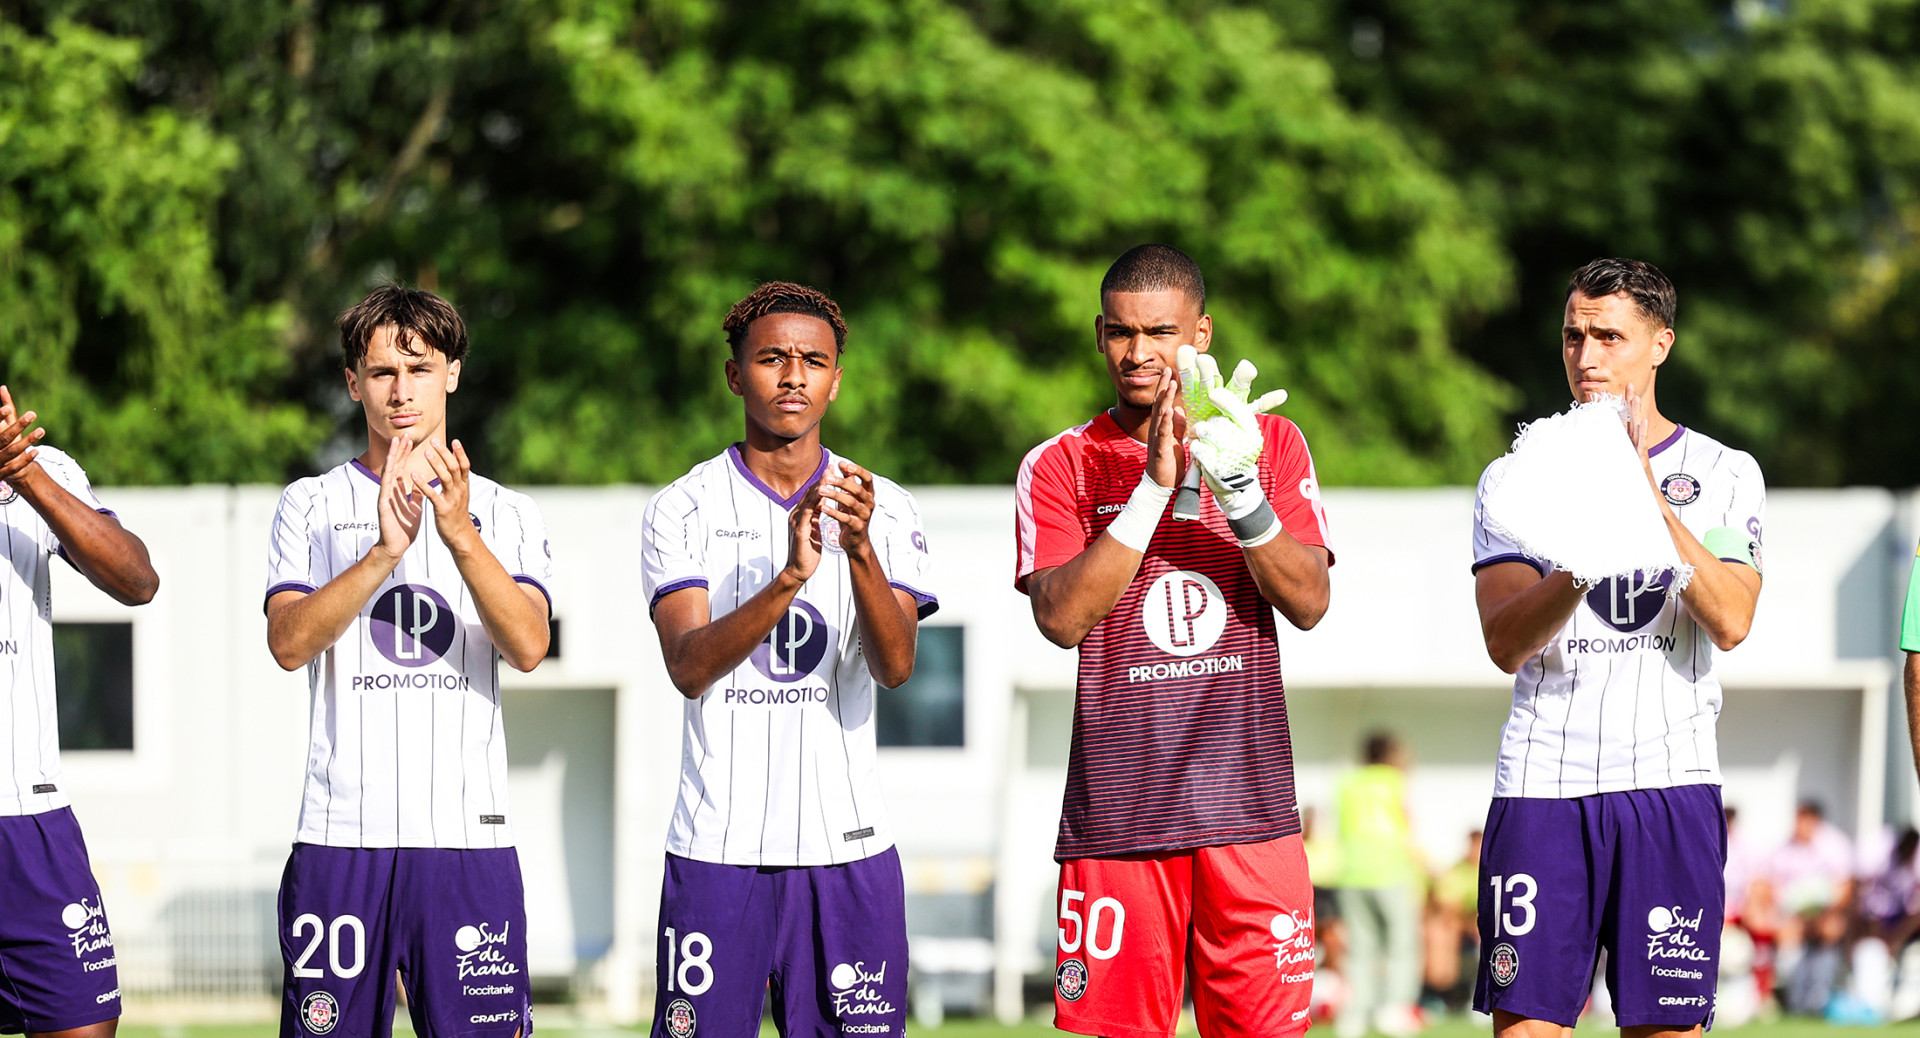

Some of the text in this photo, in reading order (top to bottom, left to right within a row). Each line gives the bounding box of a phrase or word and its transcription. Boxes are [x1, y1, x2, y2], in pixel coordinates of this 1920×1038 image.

[1096, 503, 1128, 514] CRAF
[334, 522, 370, 531] CRAFT
[715, 529, 750, 539] CRAFT
[1165, 580, 1208, 647] LP
[394, 592, 439, 660] LP
[770, 605, 813, 675] LP
[1567, 635, 1676, 654] PROMOTION
[1129, 655, 1243, 683] PROMOTION
[352, 674, 469, 691] PROMOTION
[725, 687, 828, 704] PROMOTIO
[1490, 873, 1538, 938] 13
[89, 919, 107, 936] de
[1058, 889, 1125, 960] 50
[1665, 906, 1704, 932] Sud
[473, 921, 509, 946] Sud
[1294, 931, 1312, 949] de
[1669, 929, 1696, 946] de
[292, 913, 366, 979] 20
[479, 945, 505, 962] de
[1646, 932, 1711, 961] France
[456, 951, 519, 980] France
[664, 927, 714, 996] 18
[848, 960, 887, 985] Sud
[1651, 965, 1703, 980] l'occitanie
[463, 984, 514, 995] l'occitanie
[854, 983, 882, 1001] de
[832, 989, 896, 1017] France
[1658, 996, 1699, 1006] CRAFT
[470, 1012, 509, 1023] CRAFT
[842, 1022, 890, 1034] l'occitanie
